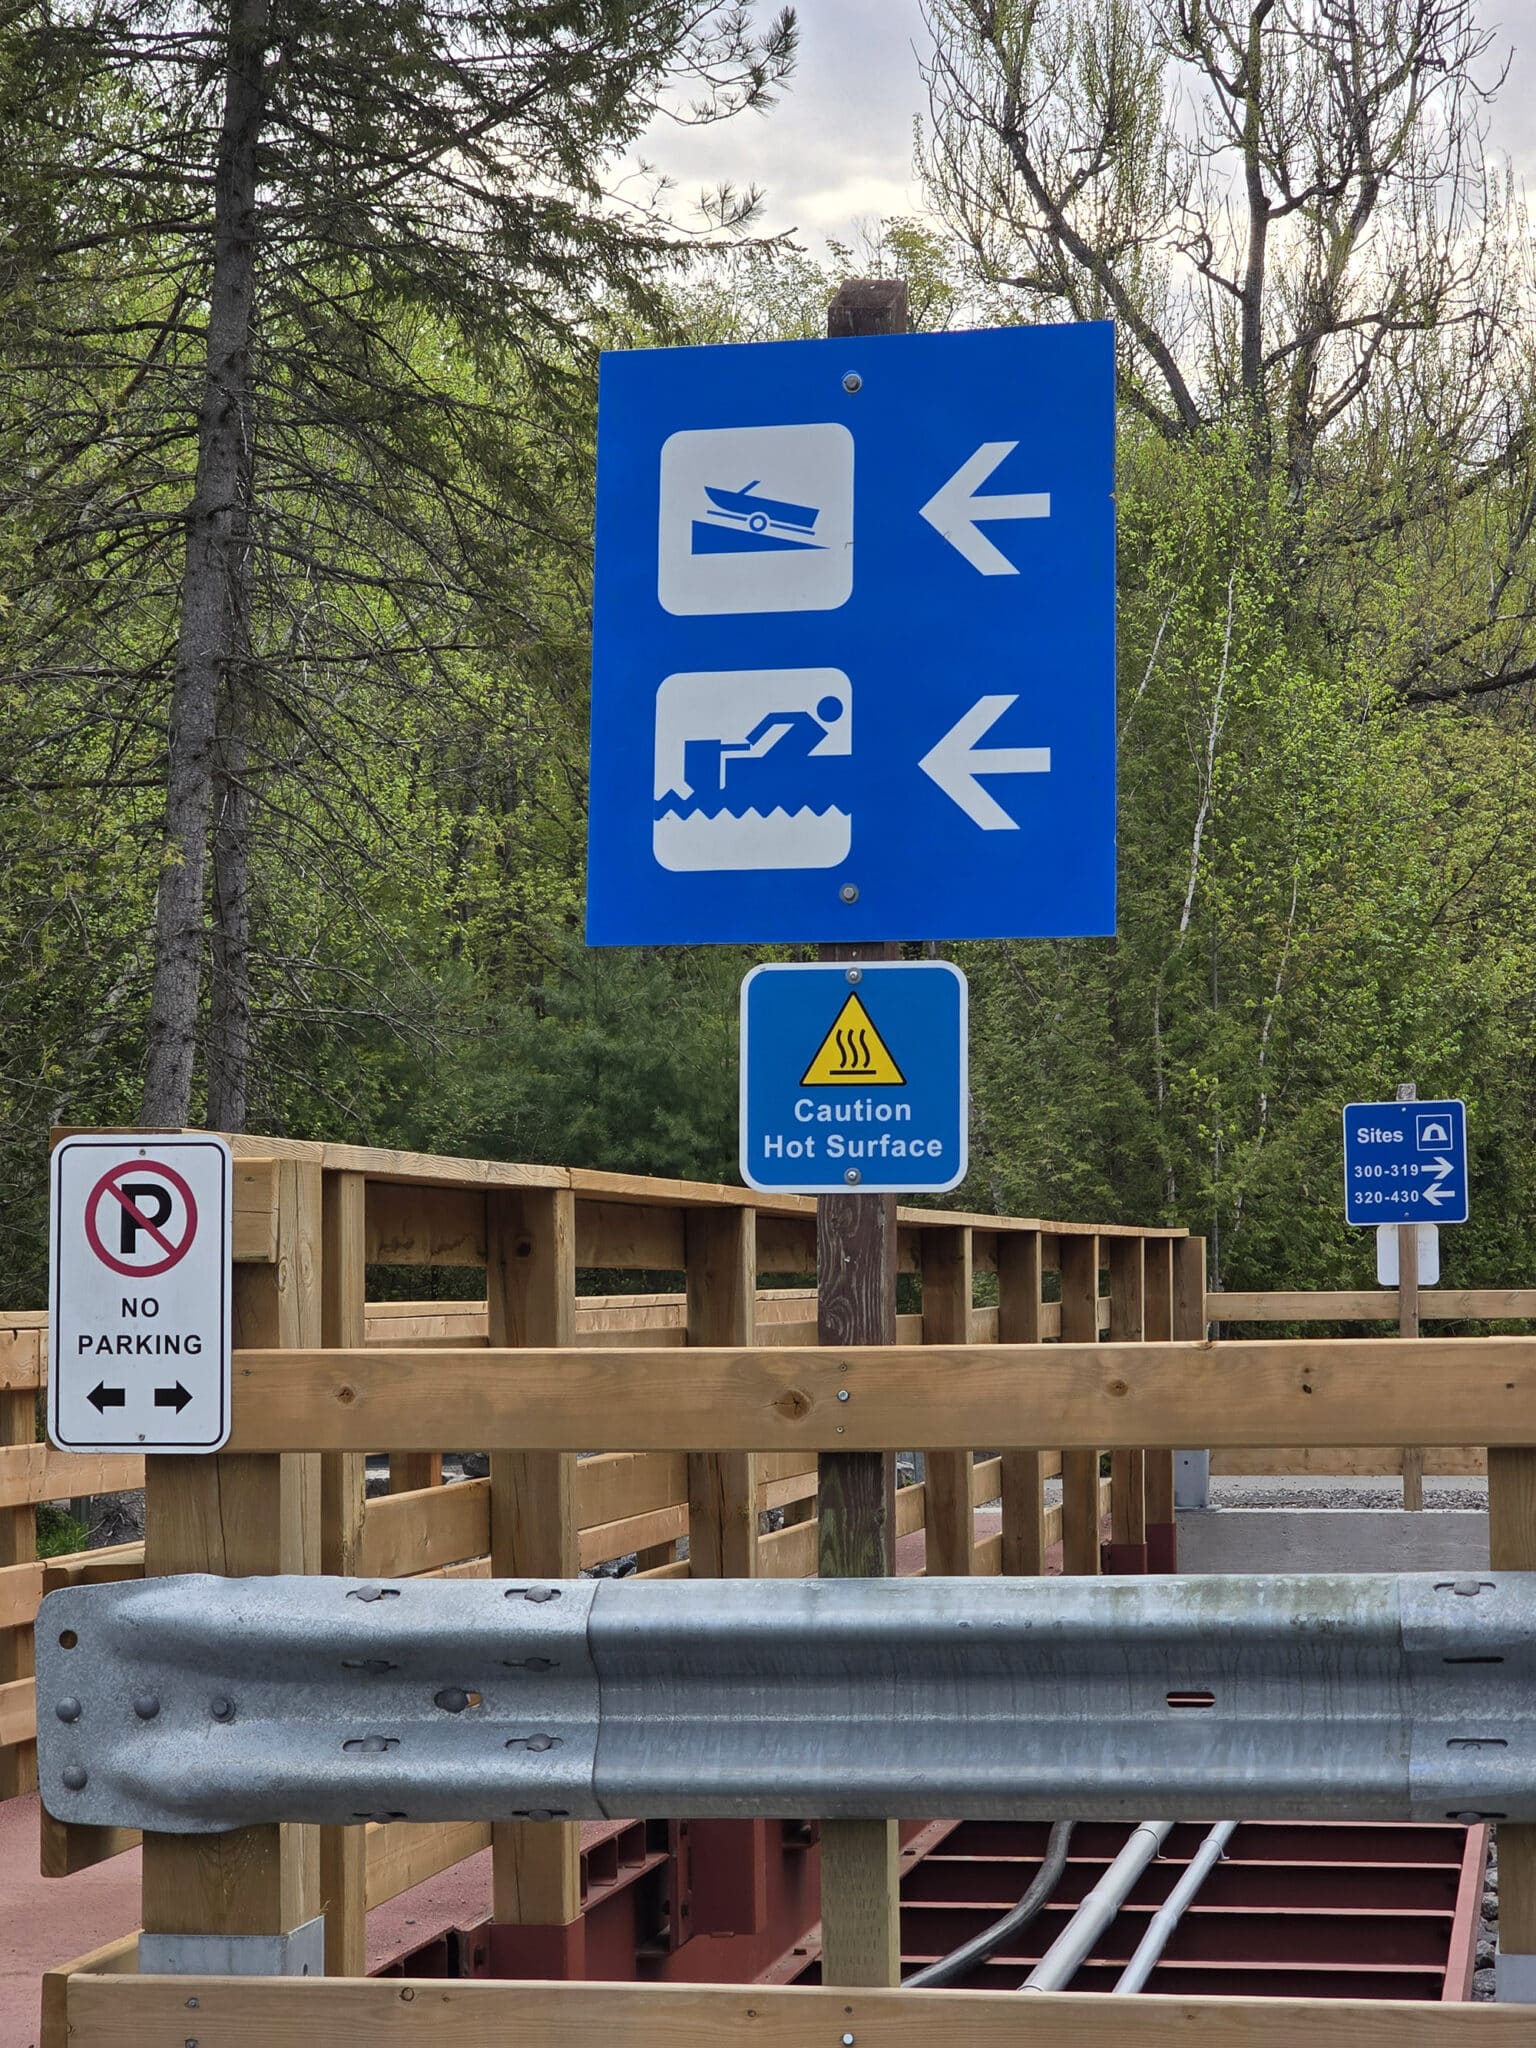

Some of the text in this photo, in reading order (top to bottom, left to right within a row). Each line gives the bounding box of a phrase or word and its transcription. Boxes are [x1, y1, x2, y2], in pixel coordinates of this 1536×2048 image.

[794, 1098, 911, 1122] Caution
[764, 1134, 943, 1158] Hot Surface
[1357, 1127, 1404, 1144] Sites
[1354, 1163, 1419, 1178] 300-319
[1354, 1190, 1420, 1204] 320-430
[121, 1297, 159, 1318] NO
[78, 1334, 203, 1355] PARKING
